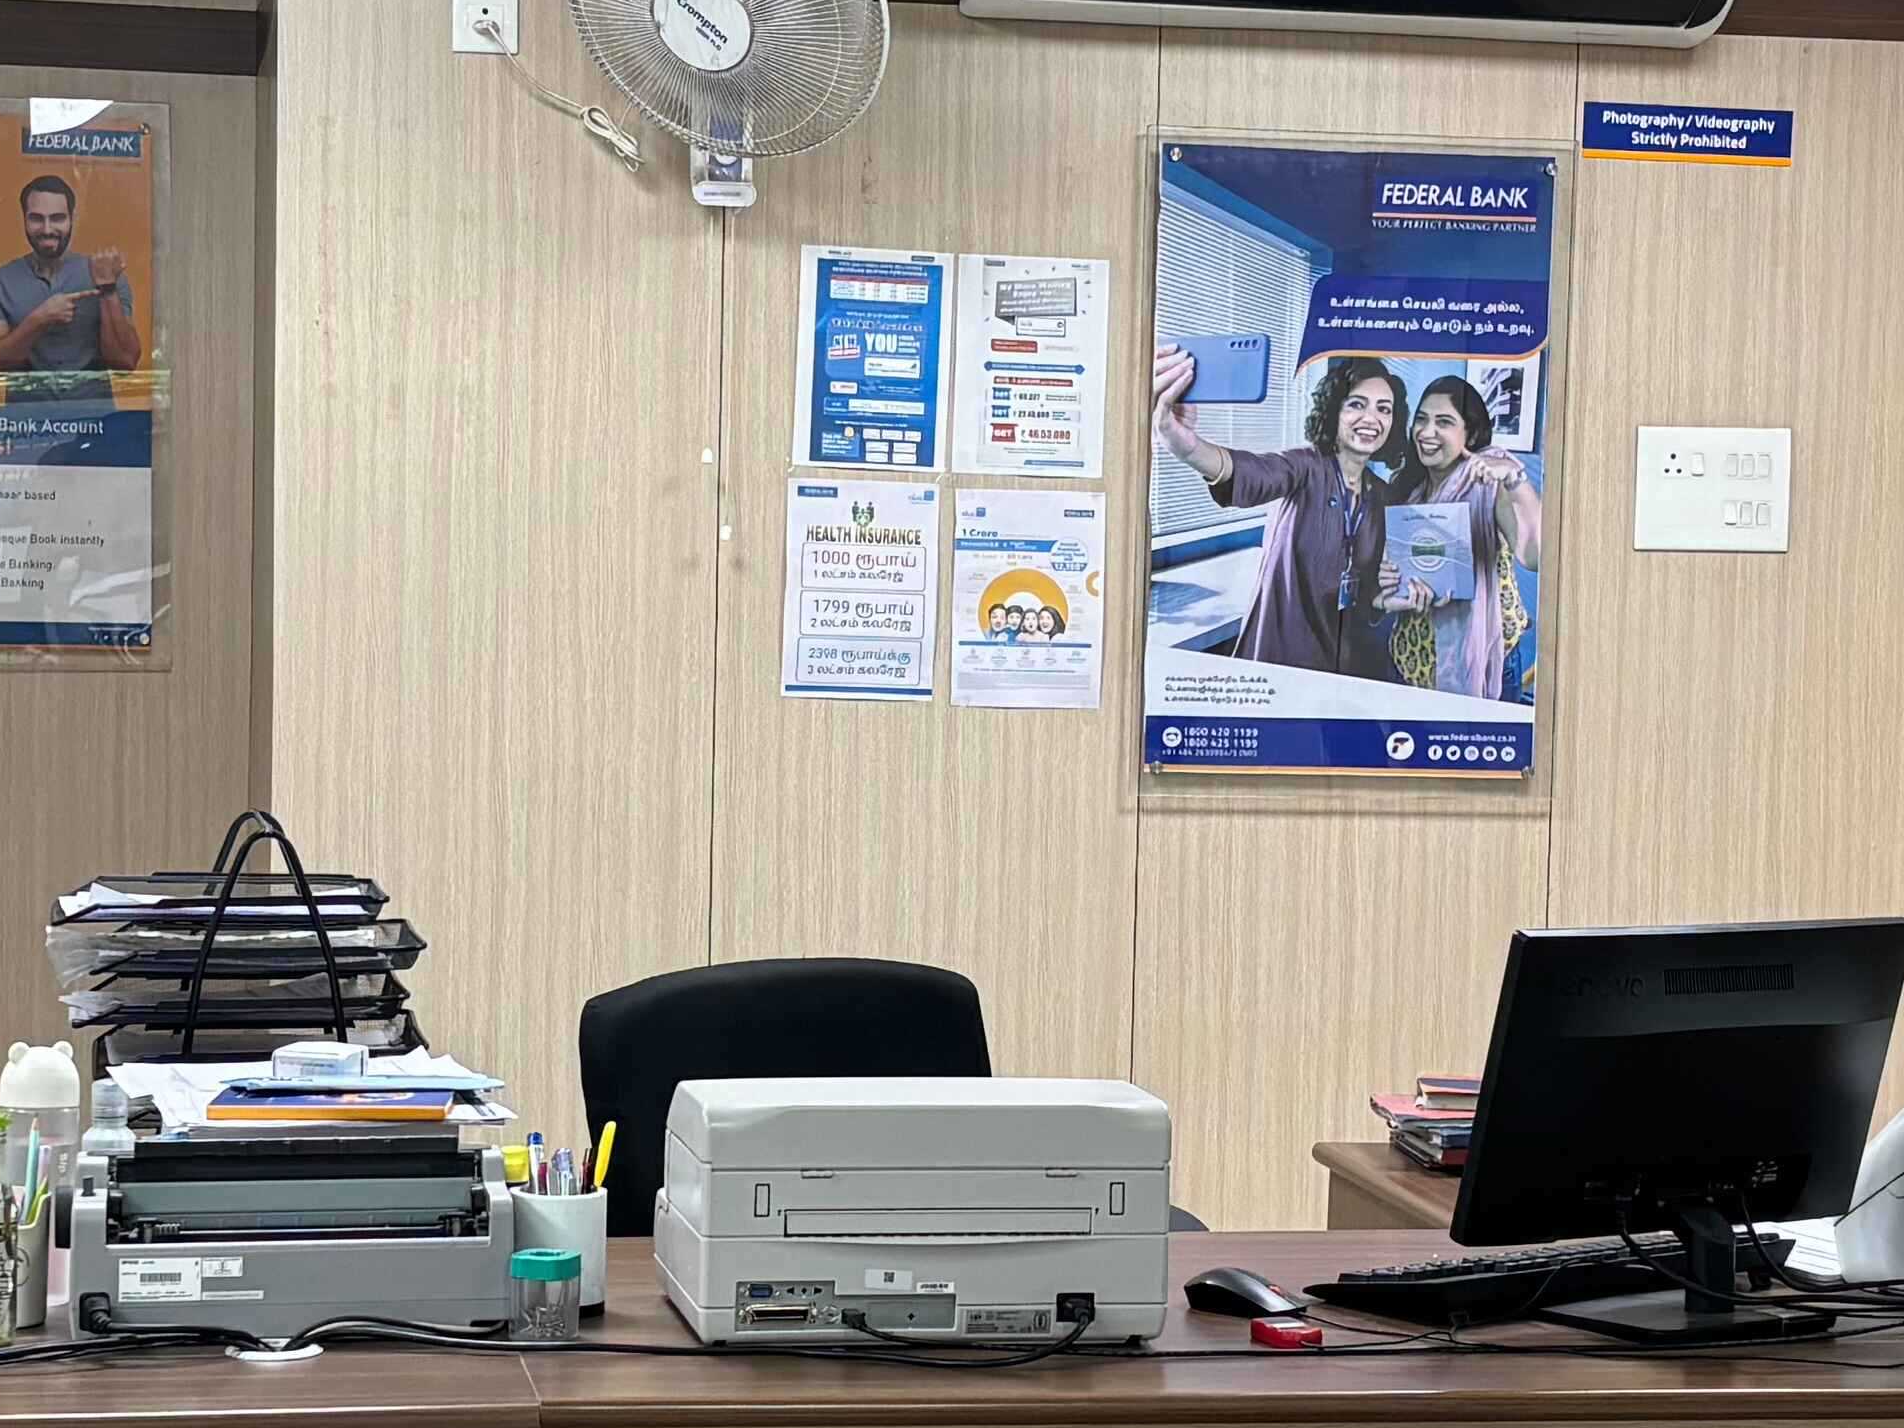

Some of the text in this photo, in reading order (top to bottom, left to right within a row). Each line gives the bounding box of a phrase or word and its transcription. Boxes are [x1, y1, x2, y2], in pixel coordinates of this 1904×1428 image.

[1695, 115, 1775, 134] Videography
[28, 133, 134, 153] FEDERAL BANK
[1631, 132, 1747, 149] Strictly Prohibited
[1382, 183, 1528, 208] FEDERAL BANK
[1372, 220, 1400, 229] YOUR
[1446, 222, 1490, 232] BANKING
[1493, 223, 1536, 233] PARTNER
[865, 332, 898, 353] YOU
[39, 420, 104, 434] Account
[24, 490, 56, 501] based
[30, 534, 56, 544] Book
[807, 524, 921, 545] HEALTH INSURANCE
[812, 550, 850, 565] 1000
[1, 577, 44, 590] Banking
[814, 599, 850, 613] 1799
[810, 618, 816, 628] 2
[808, 648, 838, 659] 2398
[808, 665, 814, 674] 3
